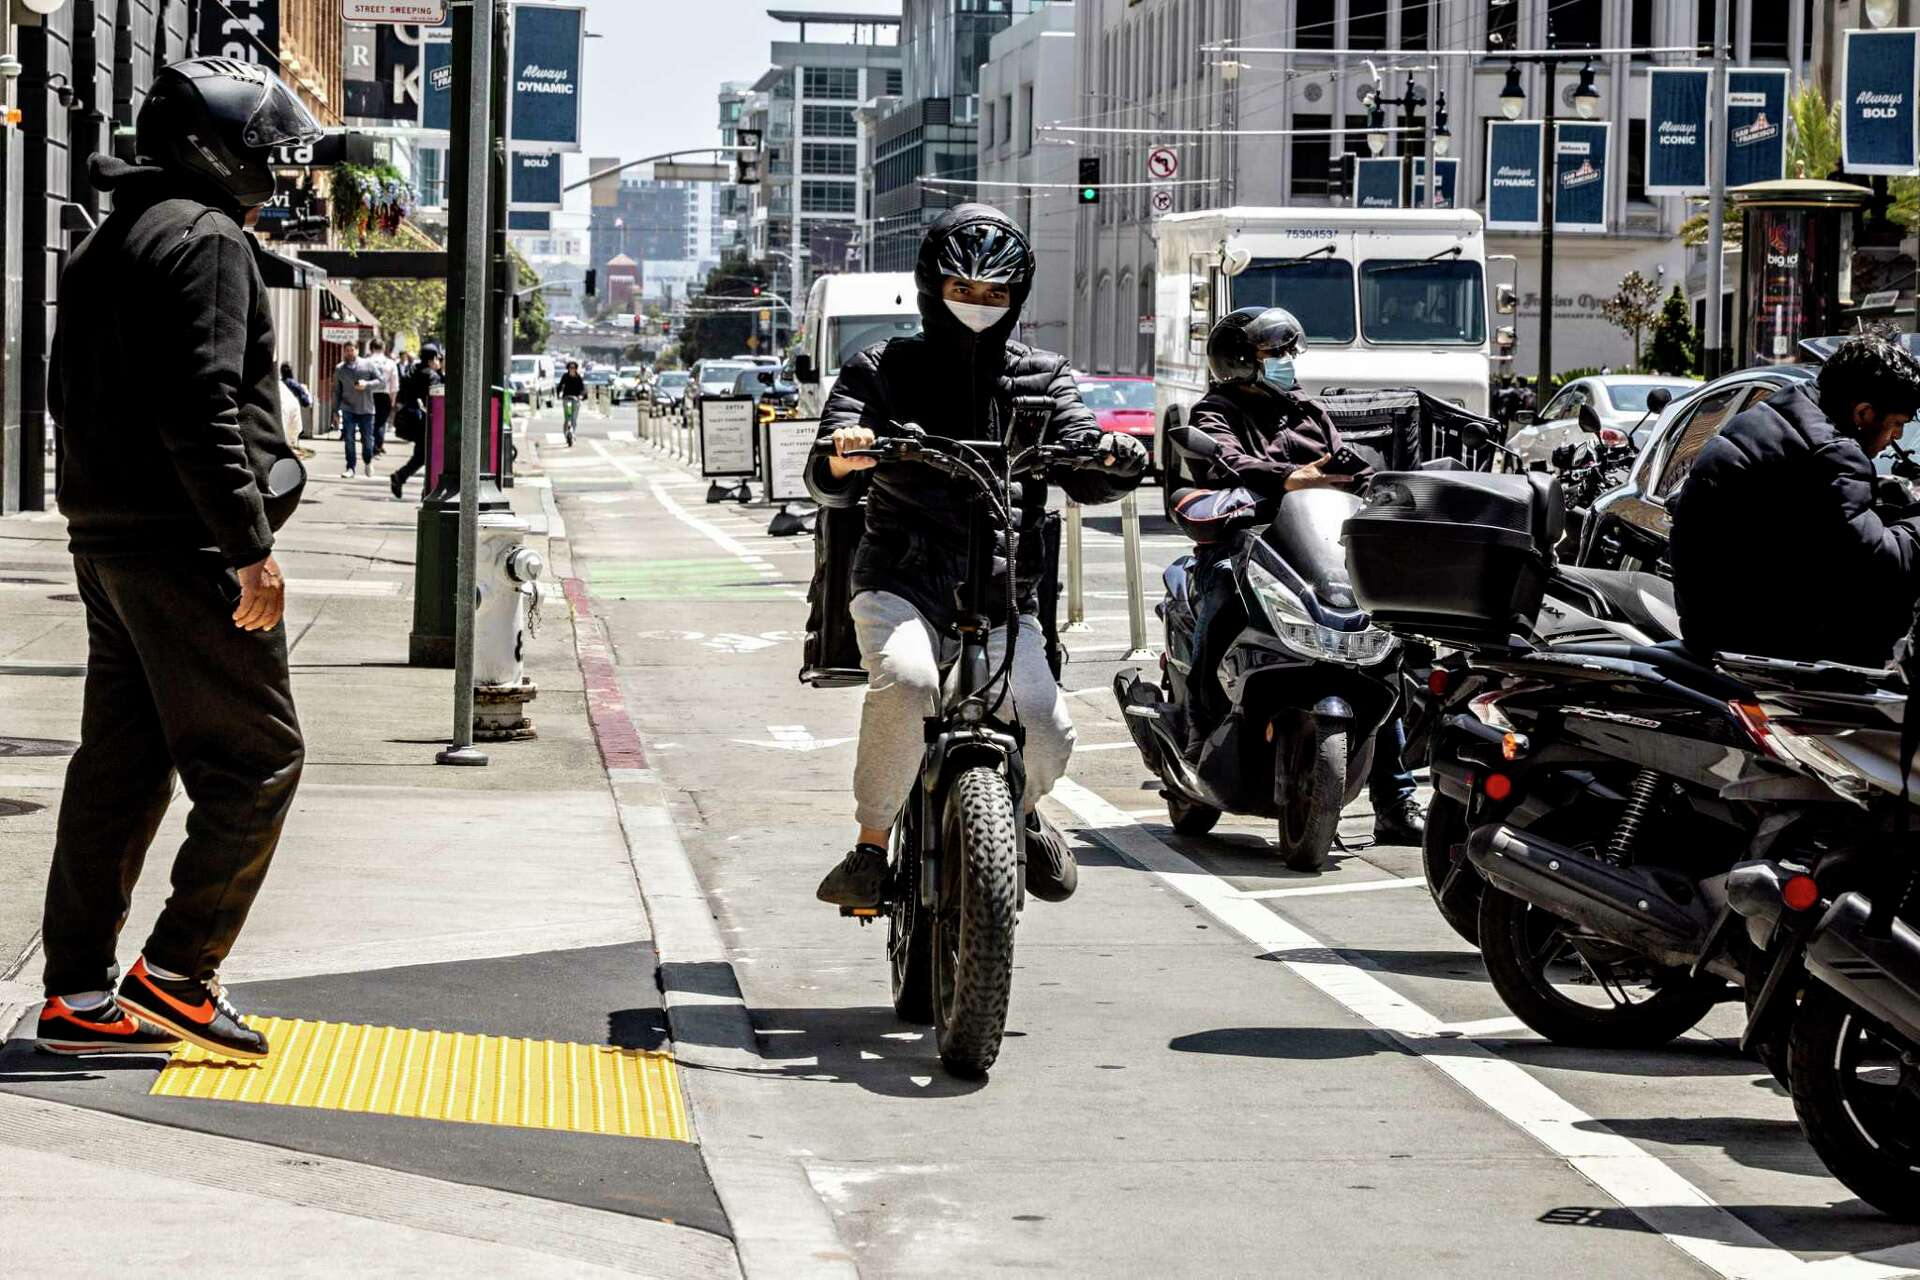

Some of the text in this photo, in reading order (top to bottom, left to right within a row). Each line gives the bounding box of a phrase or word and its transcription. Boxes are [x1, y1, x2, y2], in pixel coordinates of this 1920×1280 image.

[354, 5, 432, 15] STREET SWEEPING
[522, 65, 567, 82] Always
[517, 81, 574, 94] DYNAMIC
[1856, 91, 1903, 107] Always
[1863, 108, 1897, 118] BOLD
[1658, 121, 1696, 135] Always
[1660, 136, 1696, 145] ICONIC
[523, 159, 549, 168] BOLD
[1497, 166, 1532, 178] Always
[1493, 178, 1535, 187] DYNAMIC
